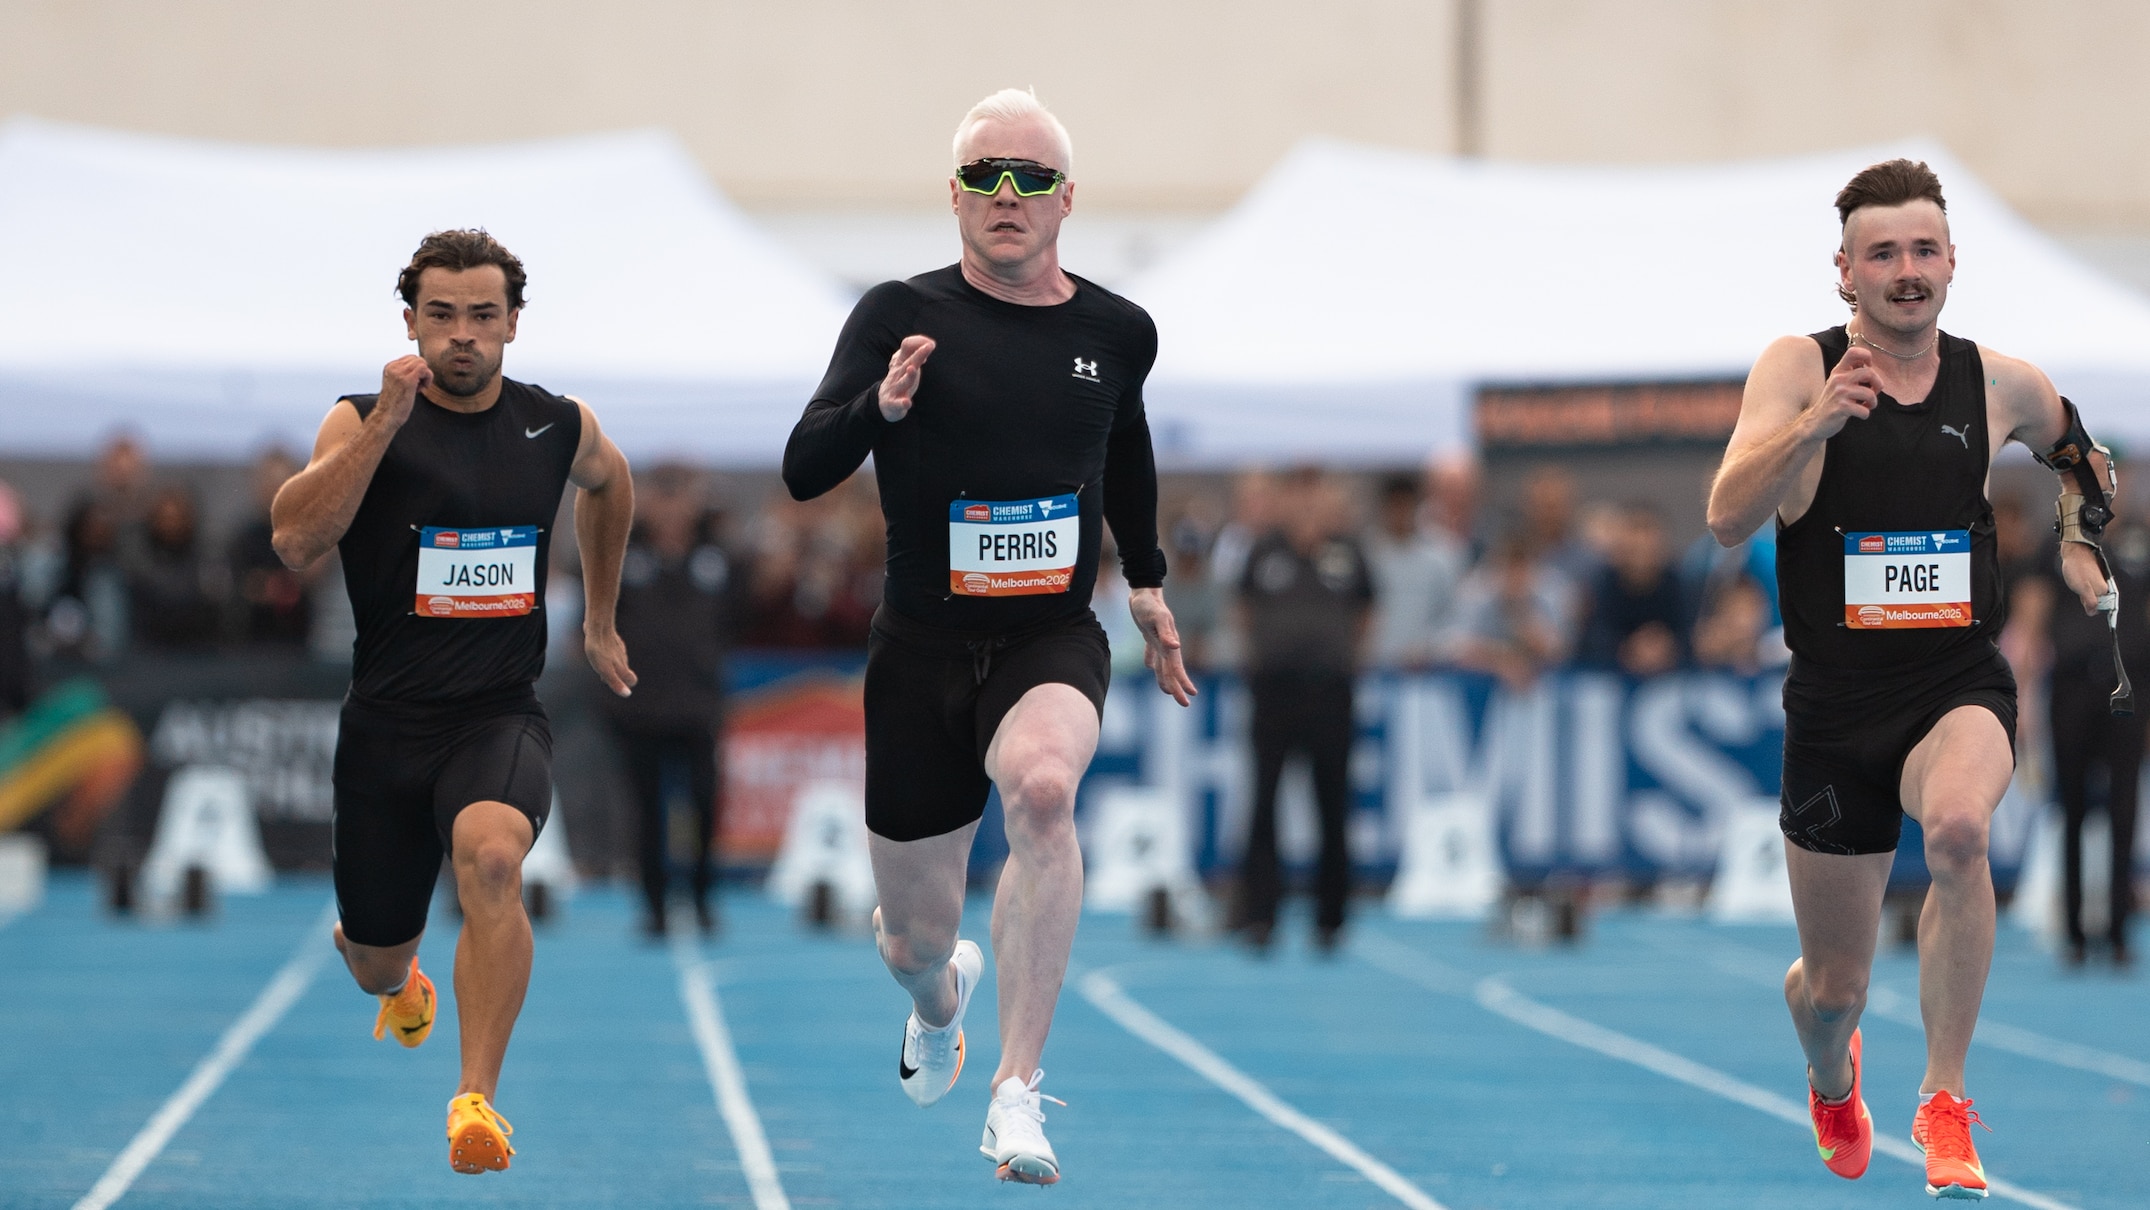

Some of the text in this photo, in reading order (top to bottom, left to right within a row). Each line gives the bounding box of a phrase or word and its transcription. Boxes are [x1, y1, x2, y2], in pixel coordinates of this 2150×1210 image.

[993, 505, 1033, 515] CHEMIST
[462, 532, 496, 542] CHEMIST
[1887, 536, 1927, 547] CHEMIST
[979, 530, 1057, 561] PERRIS
[443, 563, 514, 586] JASON
[1885, 564, 1940, 592] PAGE
[454, 599, 526, 611] Melbourne2025
[1886, 608, 1962, 621] Melbourne2025
[1098, 672, 1786, 866] HEMIS
